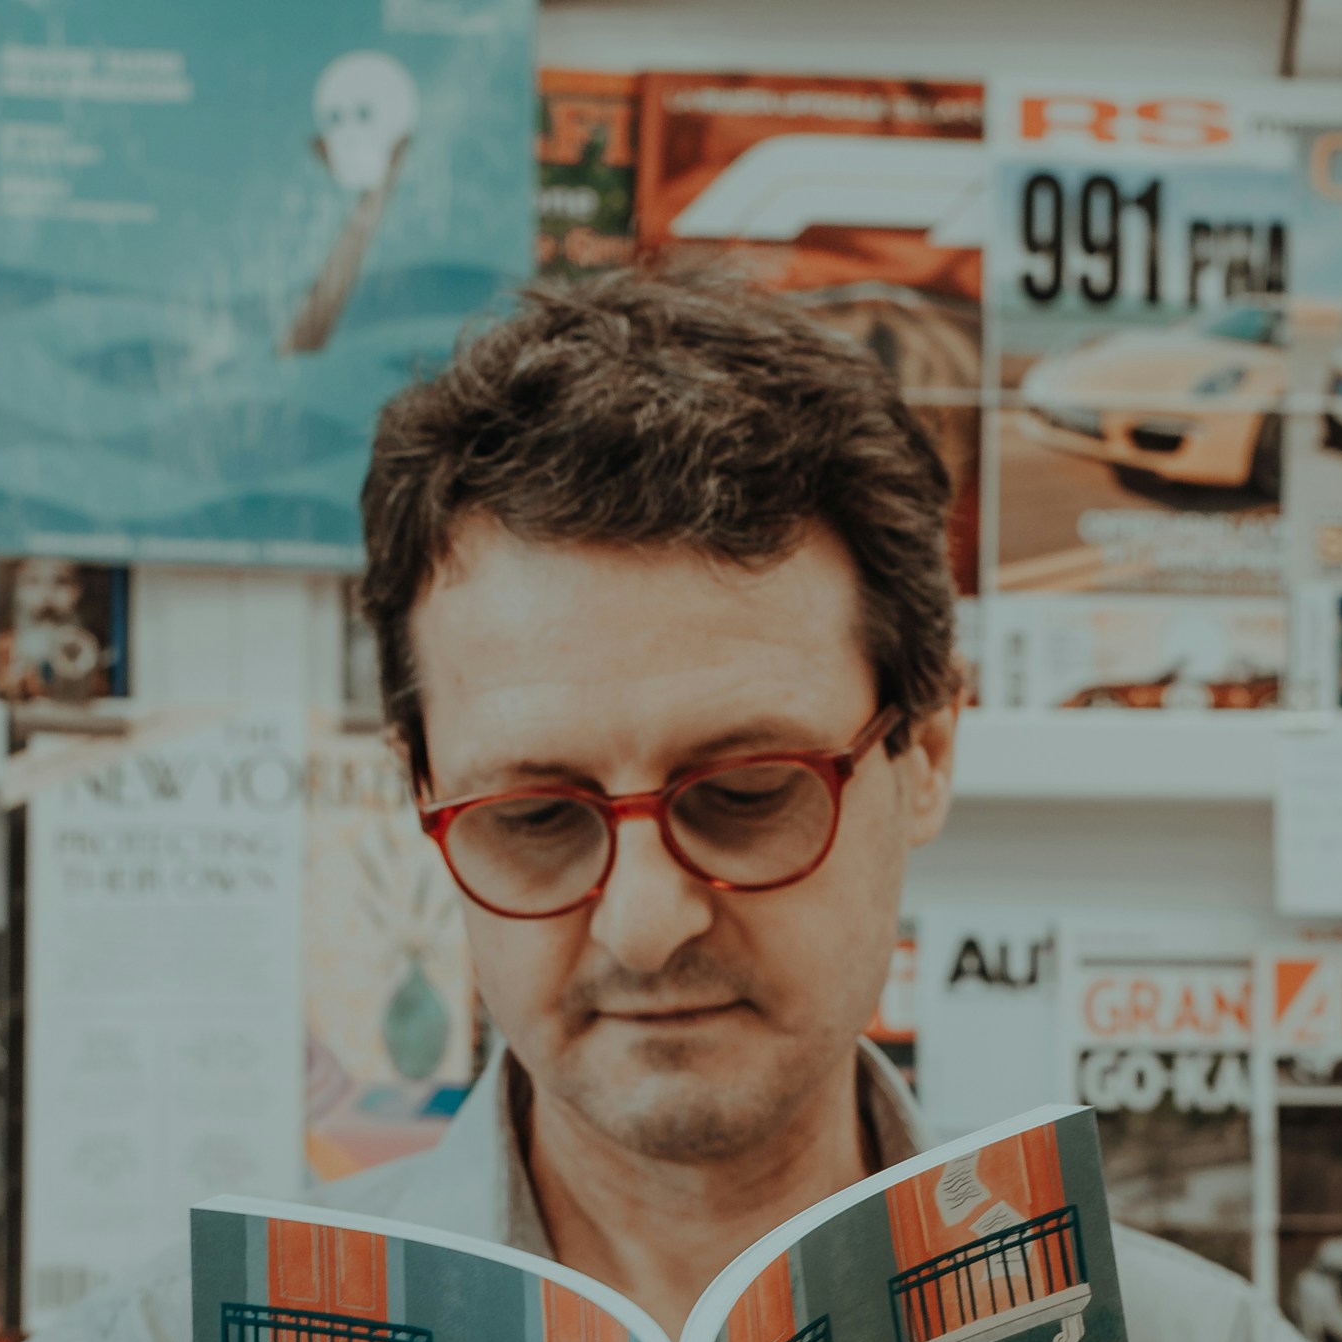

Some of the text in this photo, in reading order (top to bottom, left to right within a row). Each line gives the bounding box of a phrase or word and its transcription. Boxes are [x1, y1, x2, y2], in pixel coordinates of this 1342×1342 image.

[1021, 96, 1230, 147] RS
[1022, 171, 1161, 306] 991
[1083, 974, 1254, 1038] GRAN
